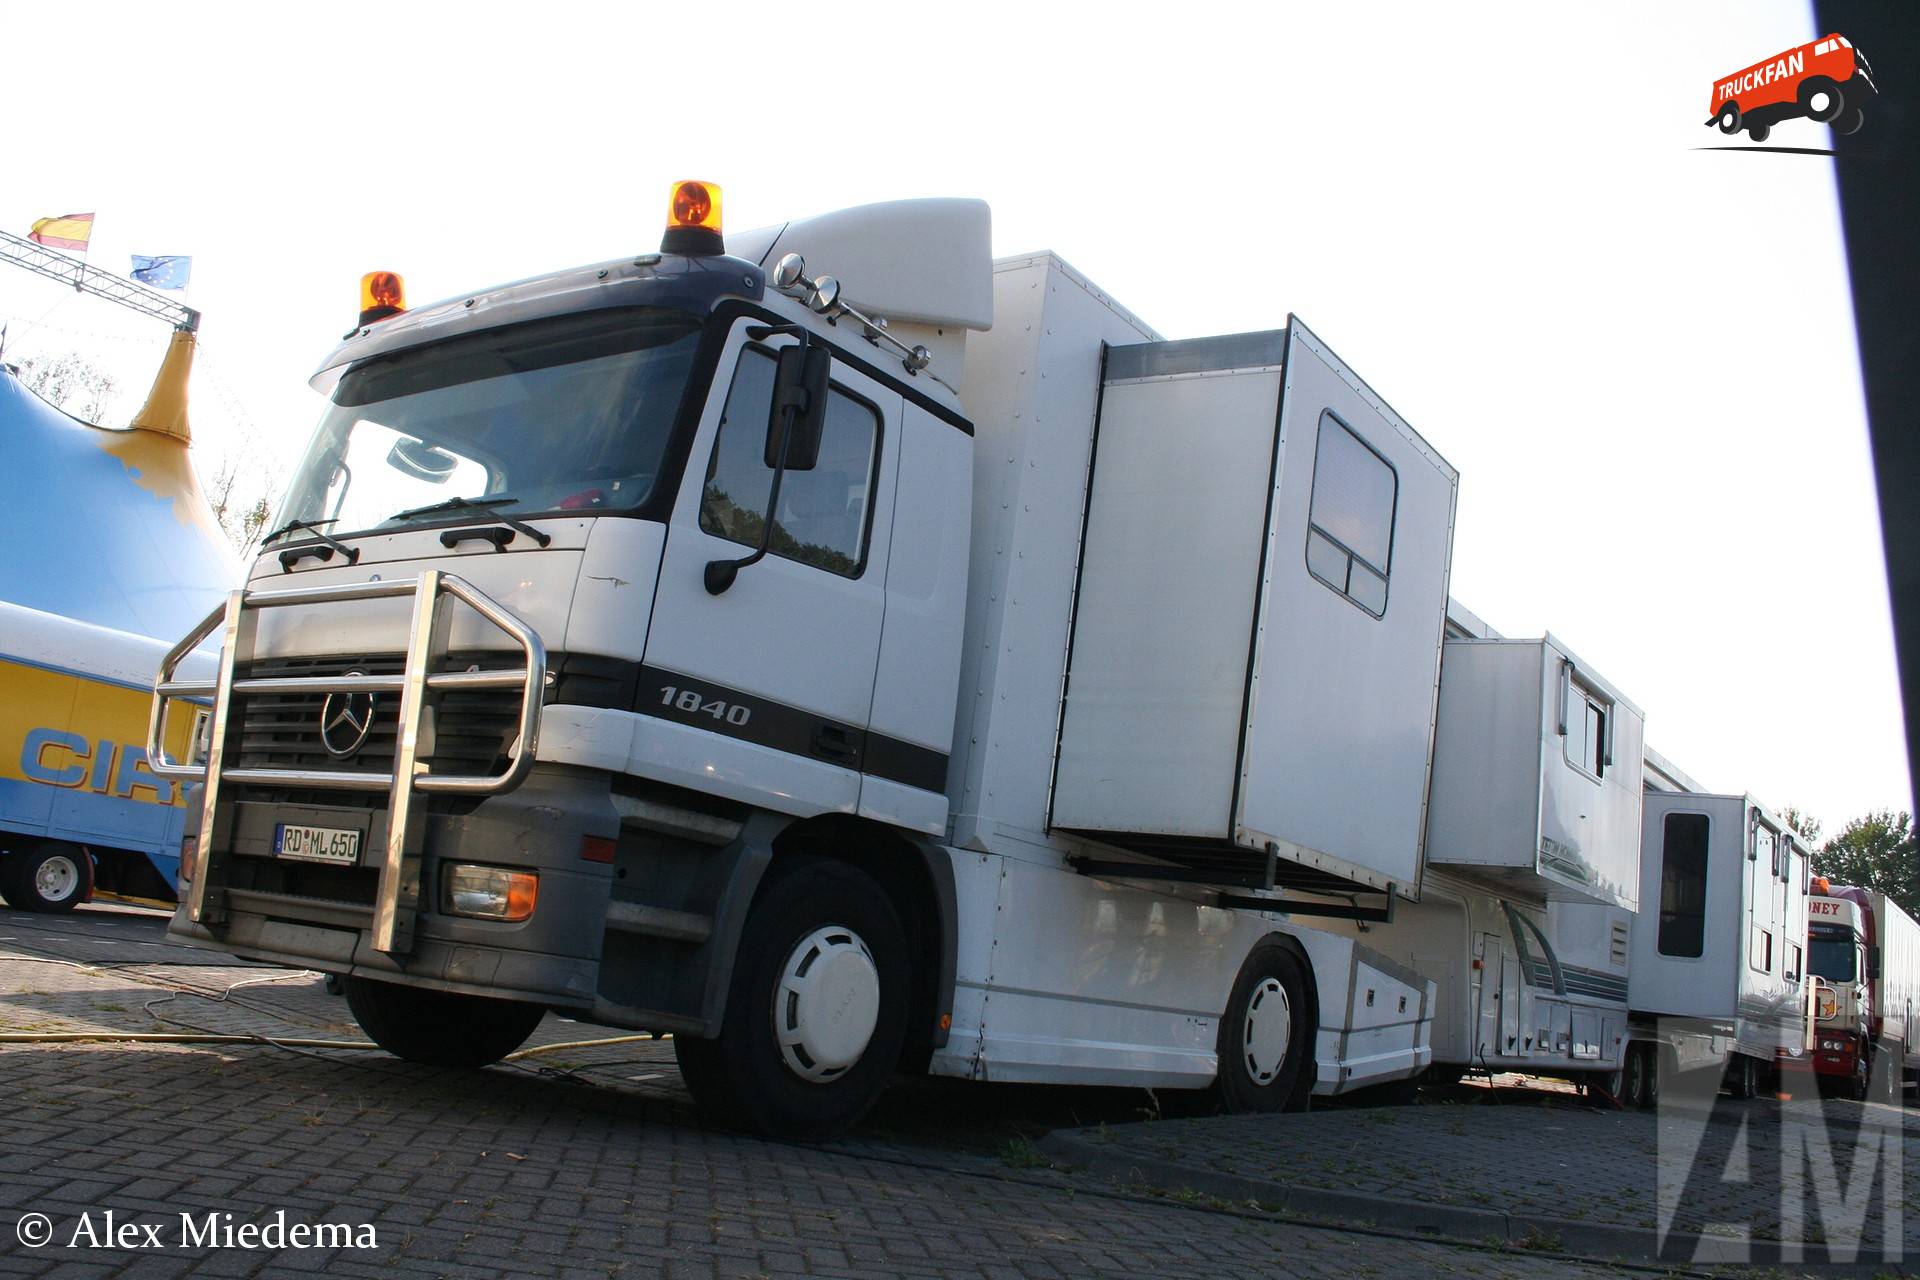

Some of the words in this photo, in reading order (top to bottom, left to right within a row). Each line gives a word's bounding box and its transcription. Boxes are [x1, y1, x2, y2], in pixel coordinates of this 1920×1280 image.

[660, 686, 751, 726] 1840
[330, 833, 357, 858] 650
[1808, 901, 1840, 916] NEY
